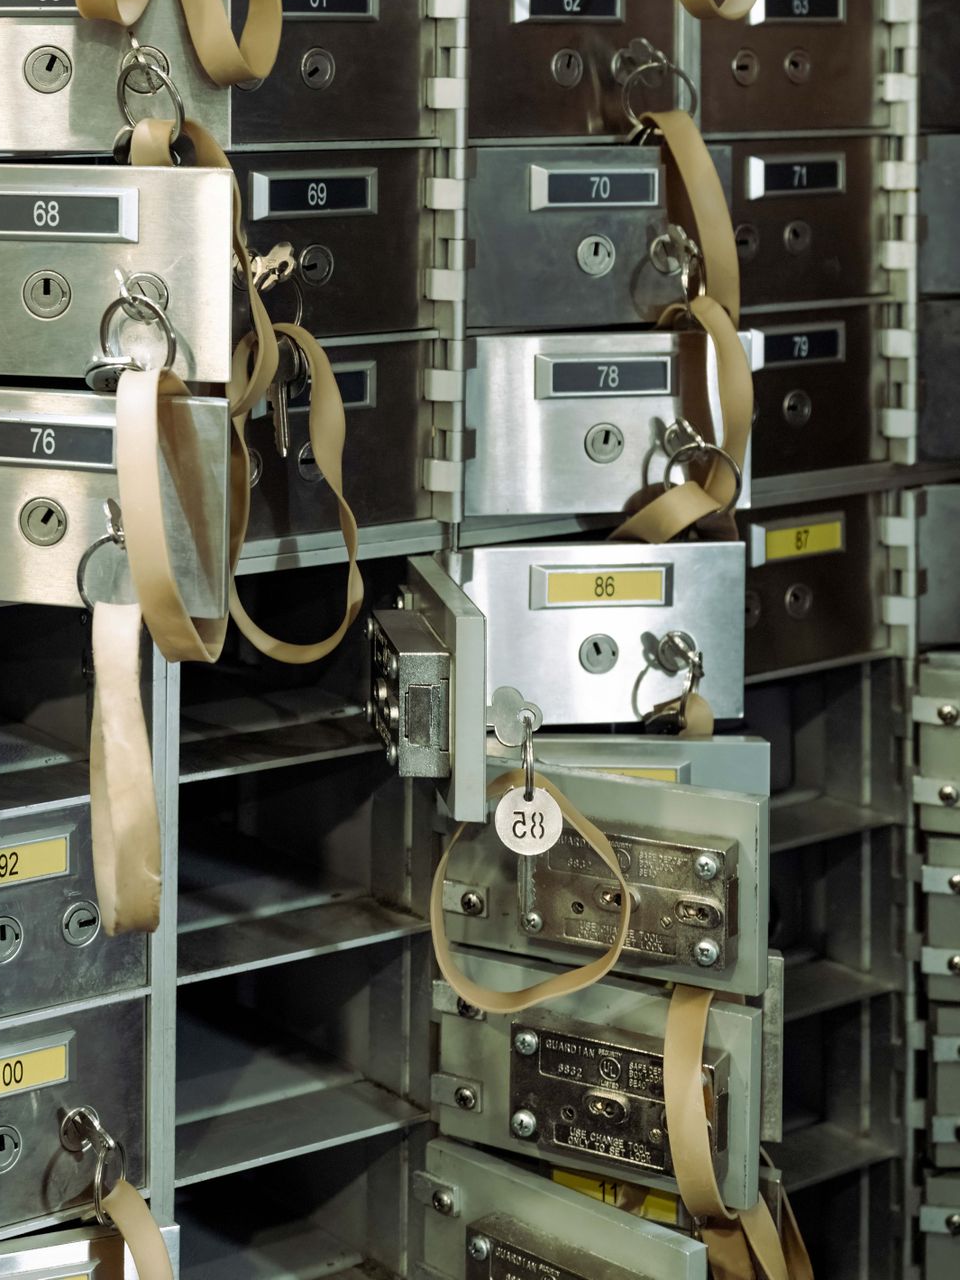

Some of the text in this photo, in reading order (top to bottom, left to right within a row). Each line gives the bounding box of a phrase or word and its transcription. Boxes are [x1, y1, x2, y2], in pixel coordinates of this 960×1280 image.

[793, 166, 806, 186] 71
[307, 183, 326, 206] 69
[589, 177, 609, 199] 70
[33, 201, 59, 227] 68
[793, 336, 808, 357] 79
[597, 366, 618, 388] 78
[30, 428, 55, 455] 76
[796, 530, 809, 550] 87
[595, 576, 614, 597] 86
[638, 930, 662, 944] TOOL
[640, 941, 663, 953] LOCK
[545, 1038, 595, 1059] GUARDIAN
[567, 1135, 651, 1164] ONLY TO SET LOCK
[569, 1126, 650, 1155] USE CHANGE TOOL
